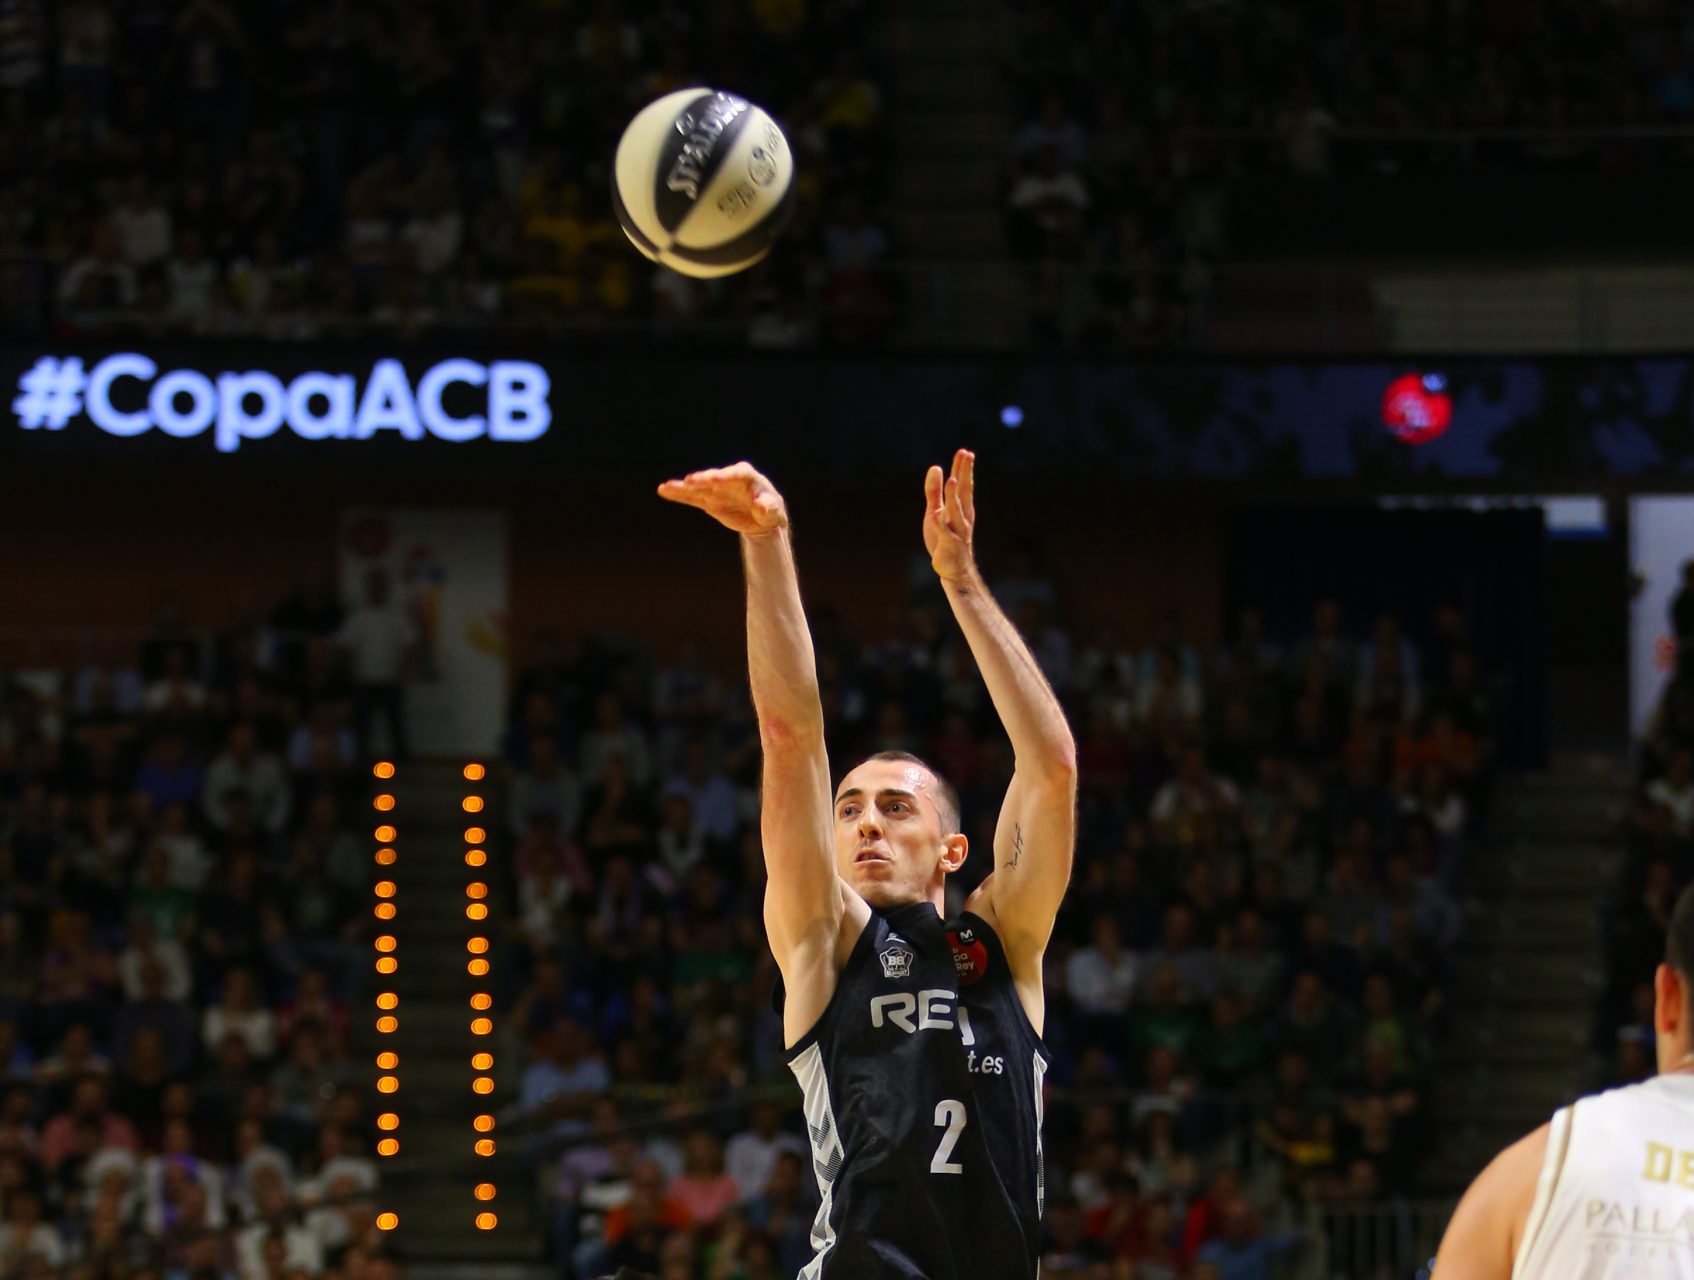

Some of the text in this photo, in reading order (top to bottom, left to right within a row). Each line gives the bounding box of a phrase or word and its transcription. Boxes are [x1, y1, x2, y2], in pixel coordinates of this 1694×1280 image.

[666, 92, 748, 201] SPALD
[12, 352, 552, 452] #CopaACB
[930, 1099, 967, 1174] 2
